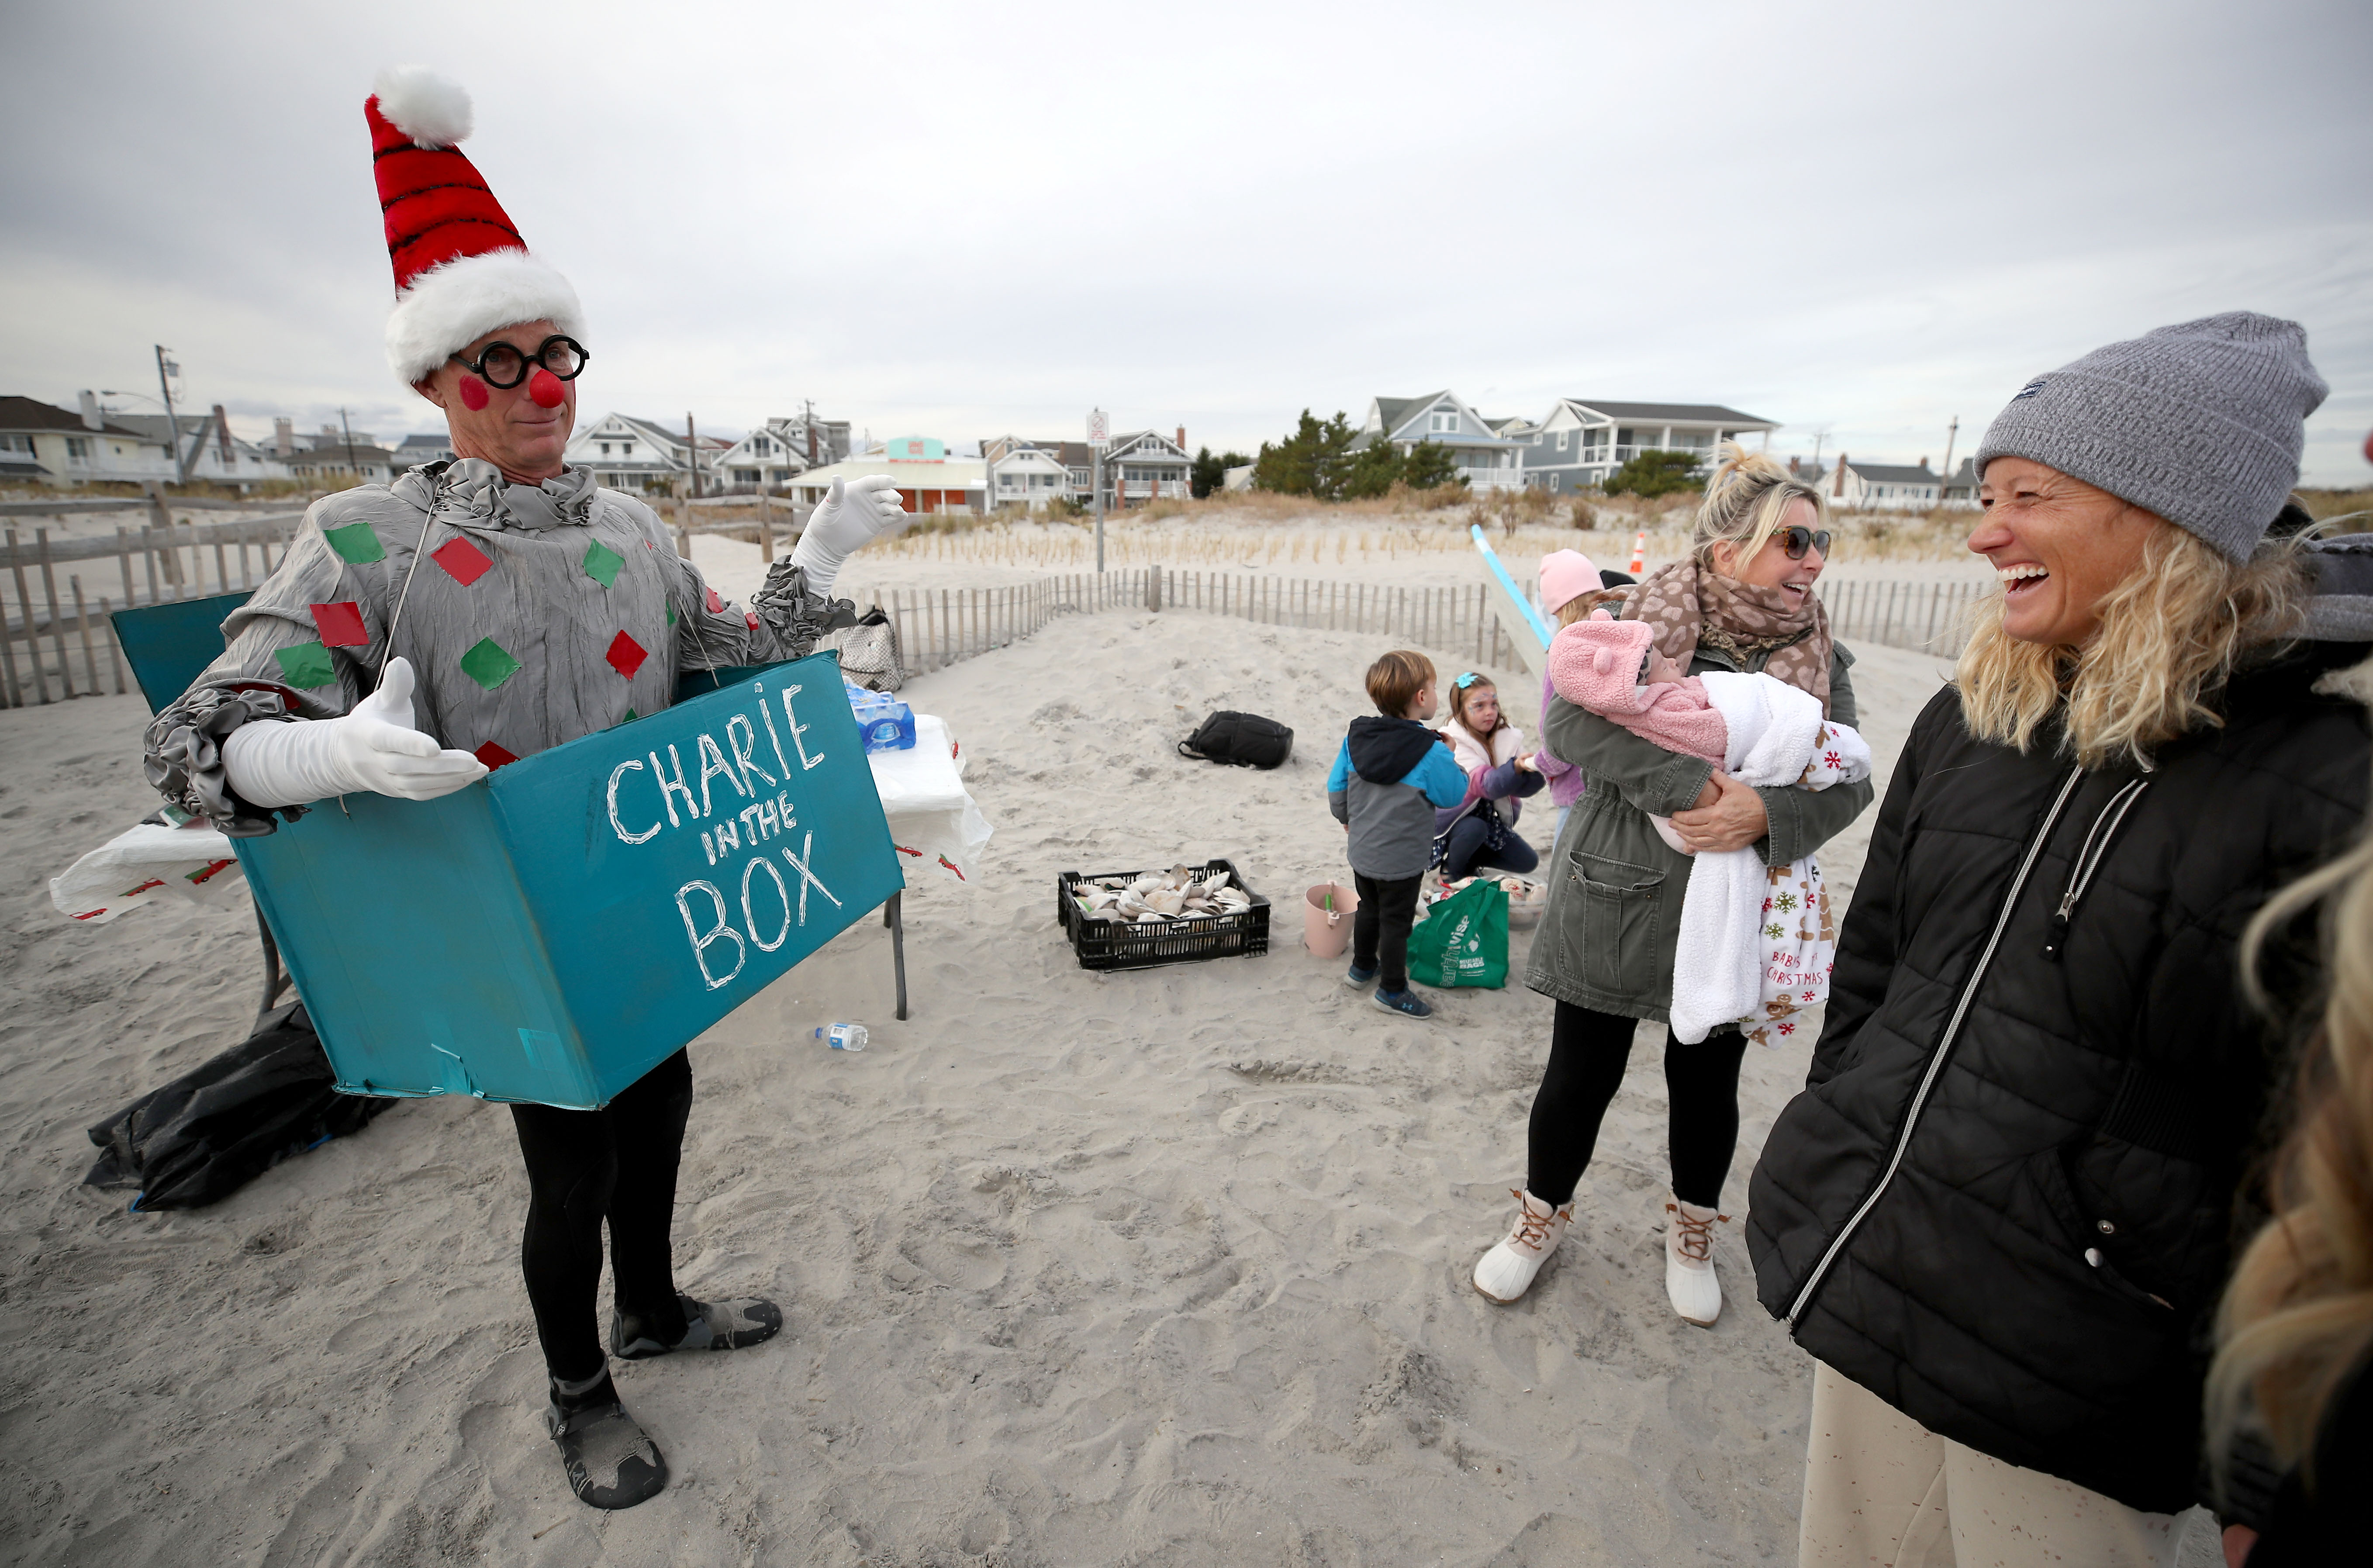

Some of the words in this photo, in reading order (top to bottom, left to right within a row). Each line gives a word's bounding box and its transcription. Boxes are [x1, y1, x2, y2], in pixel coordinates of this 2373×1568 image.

[606, 681, 825, 845] CHARIE
[700, 818, 739, 866] IN
[739, 790, 797, 846] THE
[674, 829, 843, 991] BOX
[1767, 967, 1823, 985] CHRISTMAS
